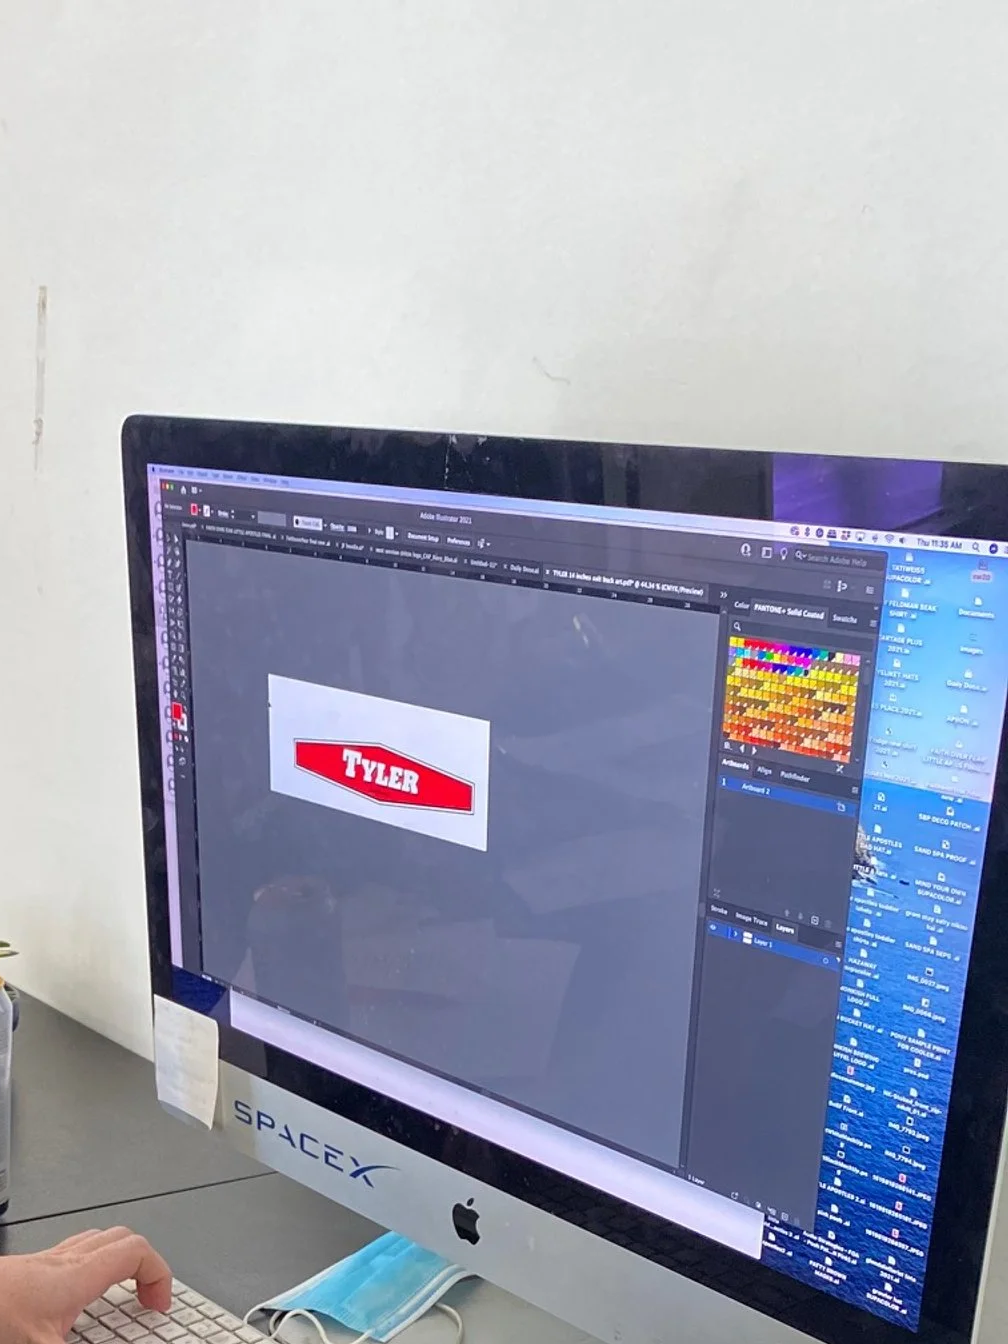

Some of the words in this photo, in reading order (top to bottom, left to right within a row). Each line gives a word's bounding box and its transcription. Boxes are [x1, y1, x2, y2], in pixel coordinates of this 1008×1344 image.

[917, 538, 930, 547] Thu
[950, 541, 963, 550] AM
[807, 553, 829, 564] Search
[830, 556, 851, 566] Adobe
[734, 600, 750, 610] Color
[787, 606, 803, 617] Solid
[803, 608, 825, 621] Coated
[958, 608, 995, 620] Documents
[721, 758, 750, 771] Artboards
[757, 765, 773, 776] Align
[342, 748, 420, 795] TYLER
[780, 770, 811, 784] Pathfinder
[741, 782, 765, 794] Artboard
[710, 904, 729, 916] Stroke
[735, 911, 752, 923] Image
[752, 915, 768, 927] Trace
[775, 922, 795, 935] Layers
[754, 937, 769, 949] Layer
[234, 1100, 400, 1188] SPACEX
